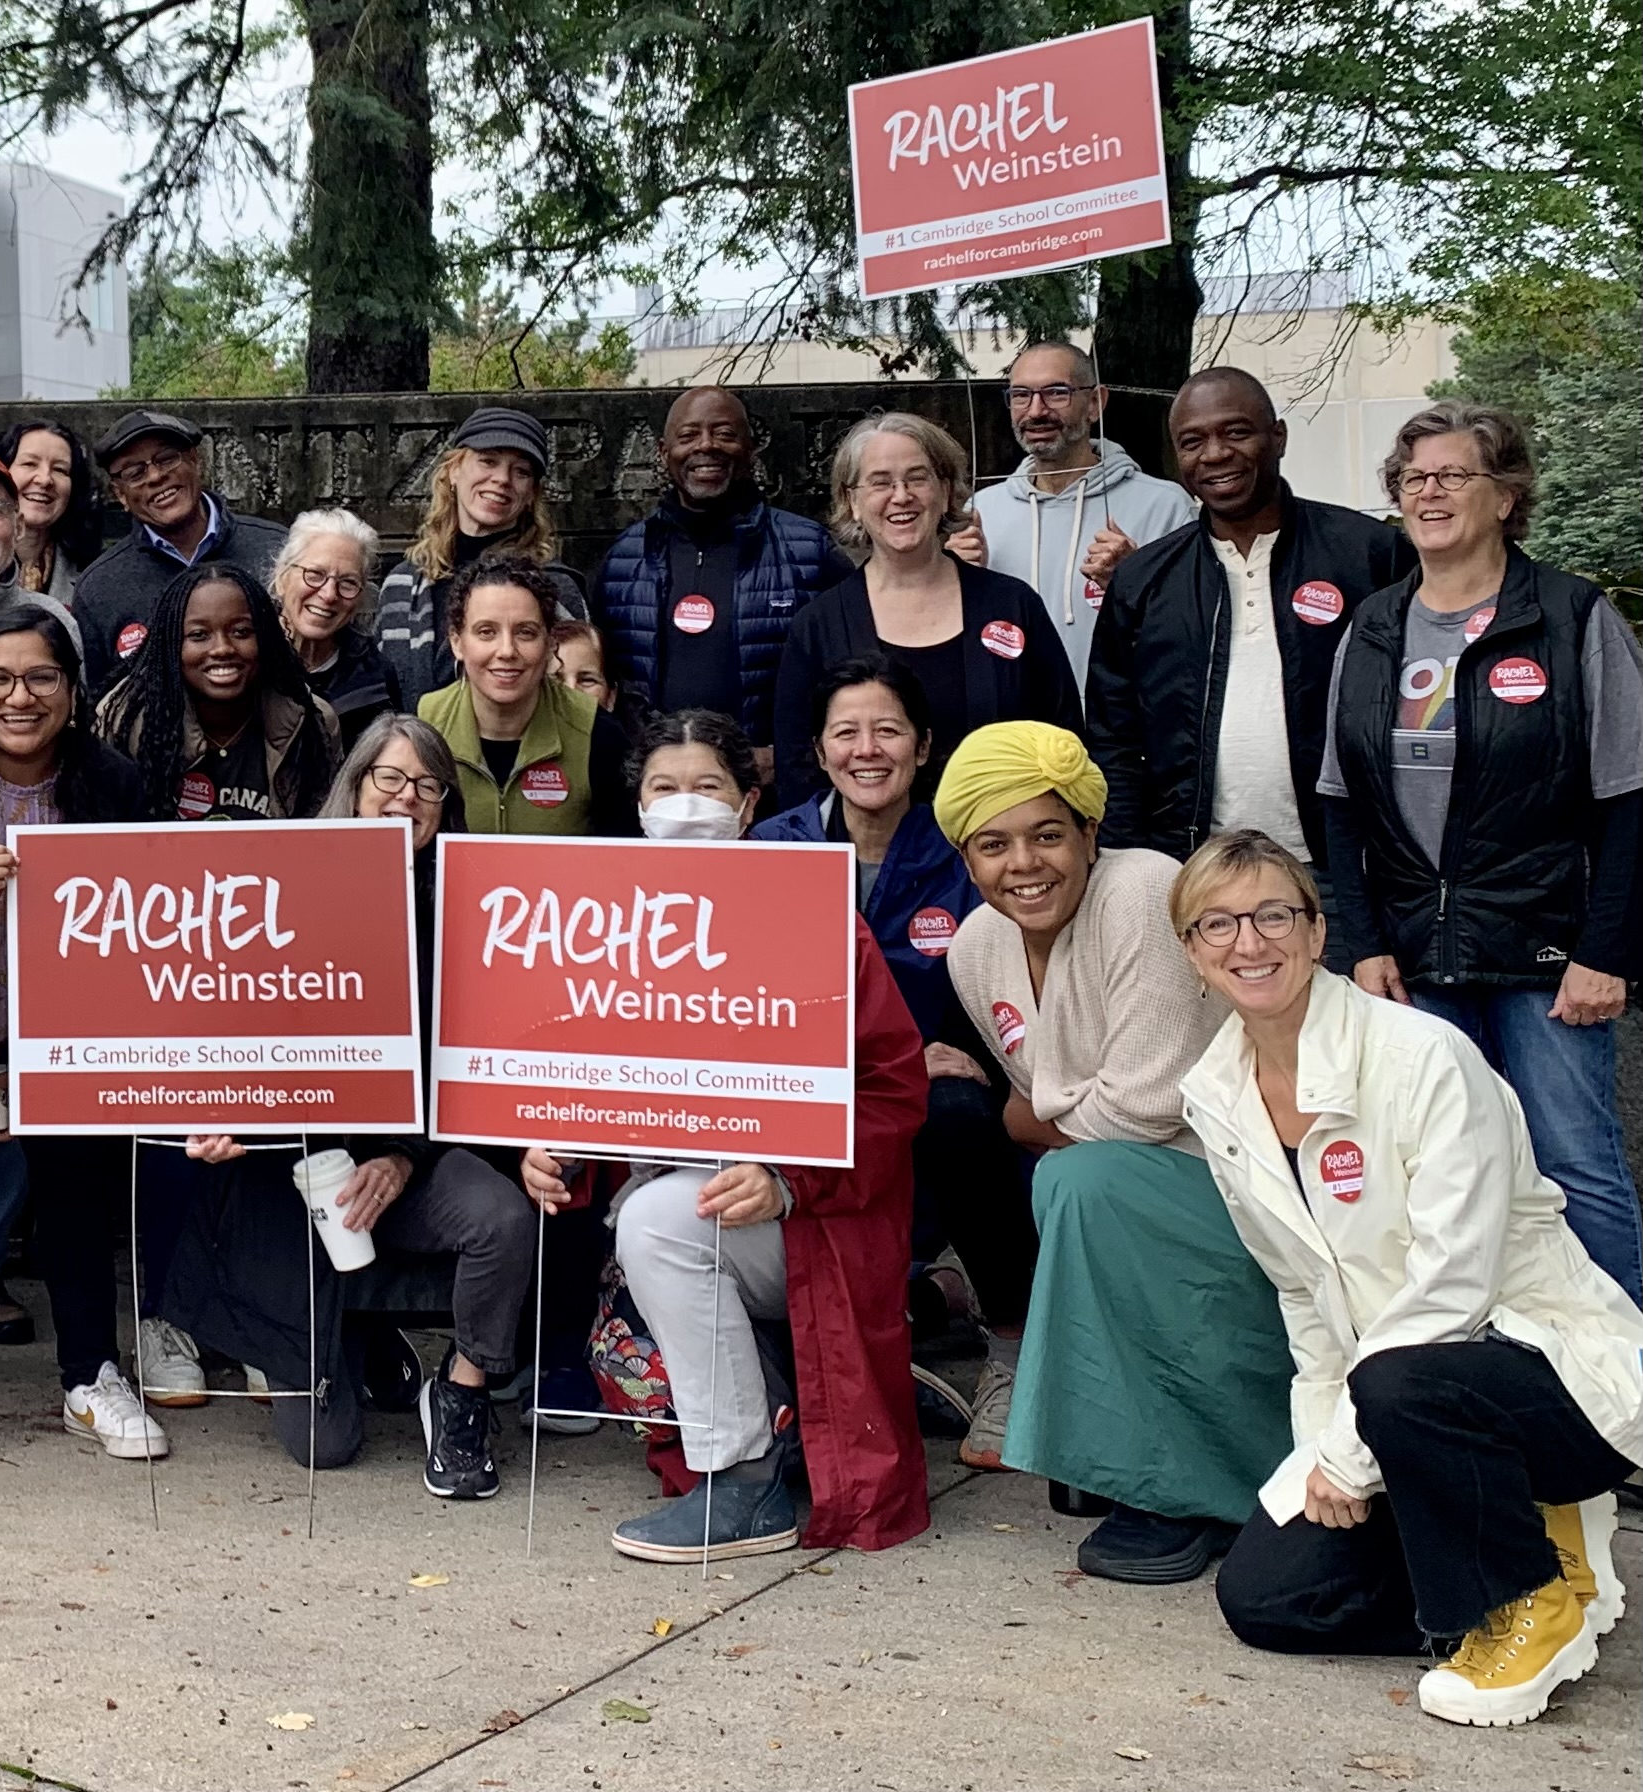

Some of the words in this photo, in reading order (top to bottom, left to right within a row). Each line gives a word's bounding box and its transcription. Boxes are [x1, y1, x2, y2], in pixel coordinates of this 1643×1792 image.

[883, 81, 1069, 172] RACHEL
[953, 133, 1122, 190] Weinstein
[885, 232, 907, 250] #1
[911, 217, 994, 243] Cambridge
[999, 207, 1050, 228] School
[1054, 187, 1139, 216] Committee
[923, 226, 1103, 271] rachelforcambridge.com
[1302, 586, 1337, 605] RACHEL
[1400, 656, 1461, 700] OT
[1495, 665, 1537, 679] RACHEL
[219, 786, 271, 818] CANA
[54, 869, 296, 961] RACHEL
[479, 884, 728, 979] RACHEL
[914, 916, 950, 929] RACHEL
[141, 961, 364, 1003] Weinstein
[565, 976, 797, 1029] Weinstein
[48, 1045, 77, 1066] #1
[83, 1044, 191, 1067] Cambridge
[197, 1044, 265, 1064] School
[271, 1044, 383, 1063] Committee
[467, 1055, 496, 1077] #1
[502, 1057, 612, 1085] Cambridge
[618, 1063, 689, 1087] School
[695, 1069, 815, 1095] Committee
[98, 1084, 335, 1107] rachelforcambridge.com
[516, 1100, 761, 1135] rachelforcambridge.com
[1324, 1150, 1361, 1171] RACHEL
